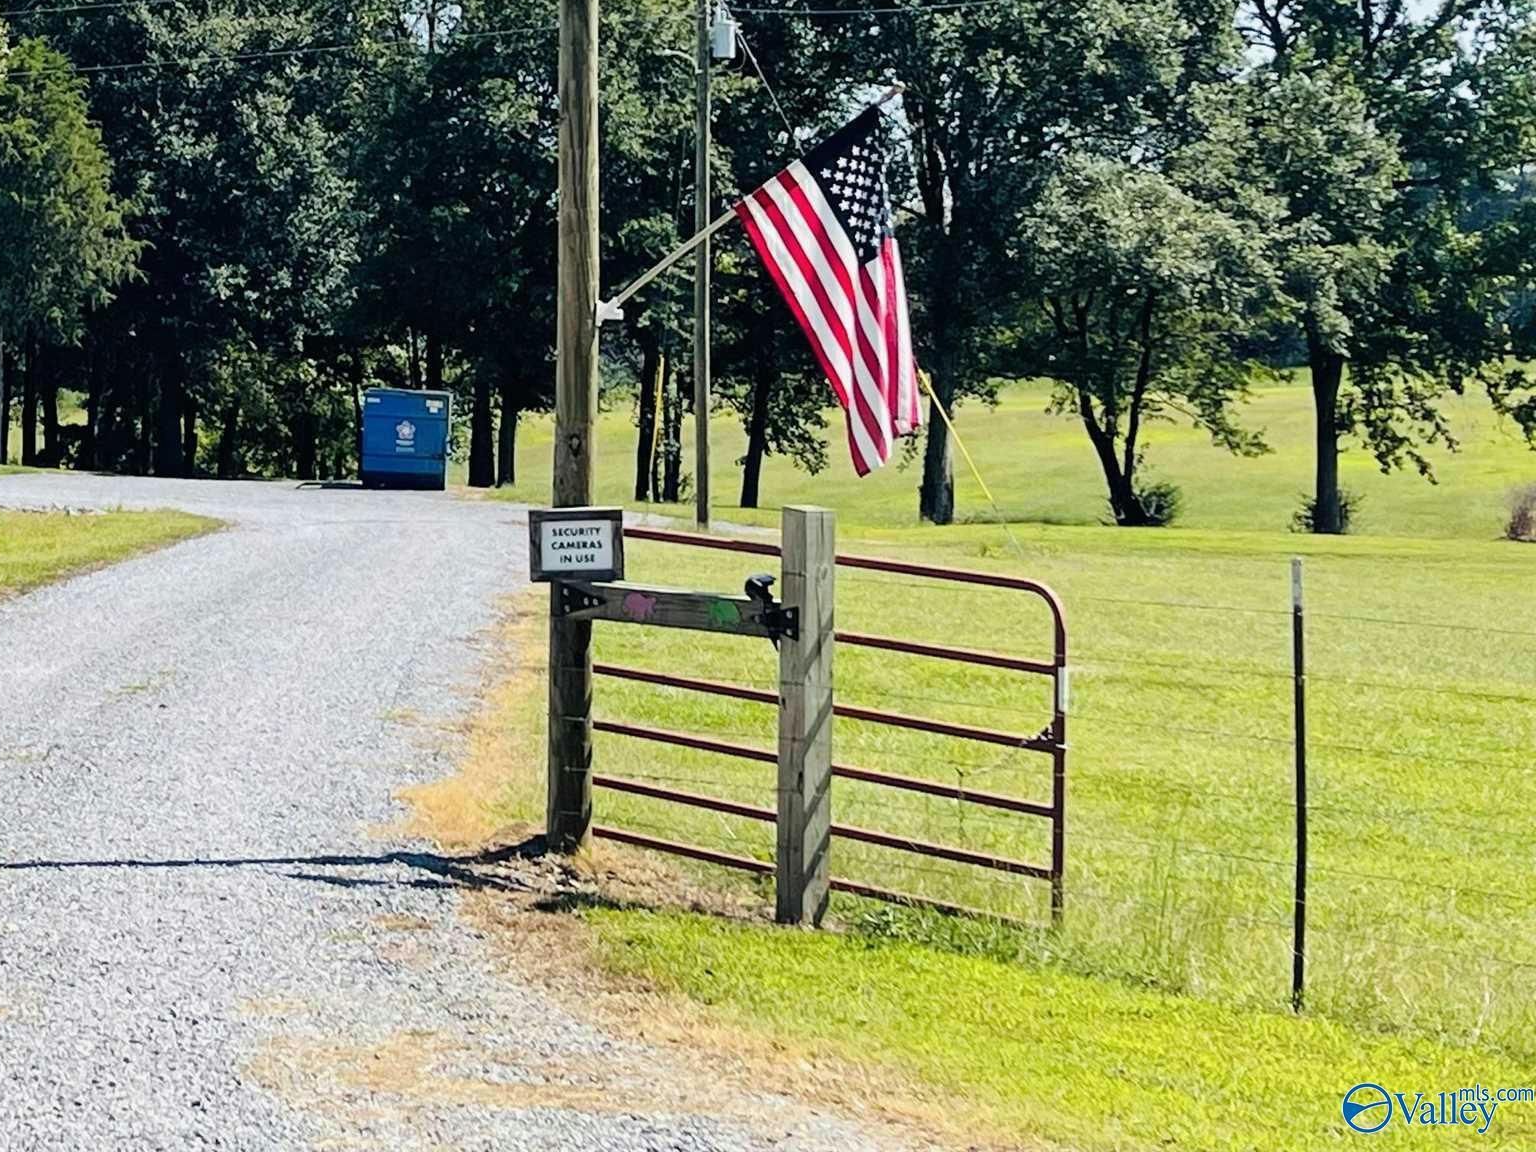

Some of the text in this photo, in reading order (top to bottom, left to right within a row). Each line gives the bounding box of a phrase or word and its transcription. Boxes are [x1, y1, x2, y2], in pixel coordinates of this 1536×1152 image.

[552, 527, 601, 536] SECURITY
[551, 540, 602, 550] CAMERAS
[560, 554, 595, 563] IN USE
